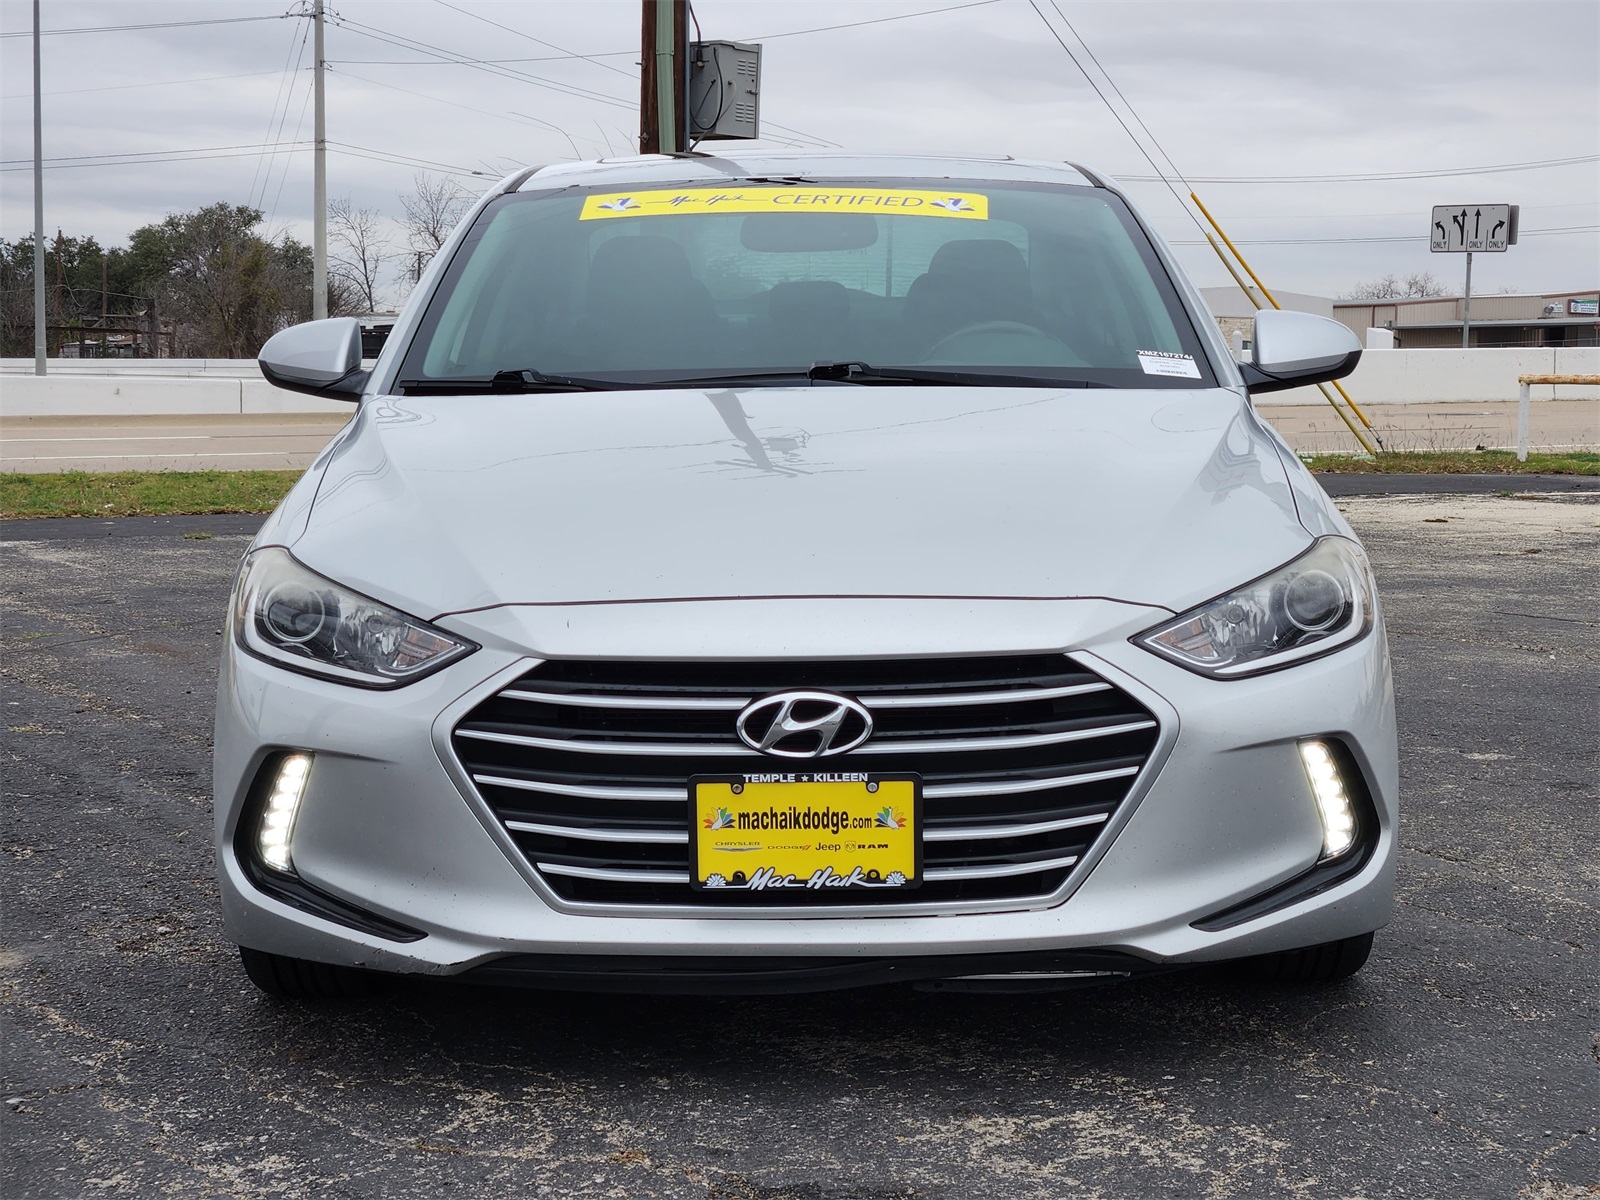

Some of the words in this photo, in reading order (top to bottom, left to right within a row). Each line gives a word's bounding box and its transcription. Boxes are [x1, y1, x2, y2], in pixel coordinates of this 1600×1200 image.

[772, 193, 925, 208] CERTIFIED
[1432, 241, 1447, 249] ONLY
[1469, 240, 1483, 248] ONLY
[1488, 240, 1505, 249] ONLY
[743, 774, 796, 783] TEMPLE
[813, 773, 868, 783] KILLEEN
[738, 806, 873, 835] machaikdodge.com
[815, 842, 841, 853] Jeep
[747, 866, 798, 890] Mac
